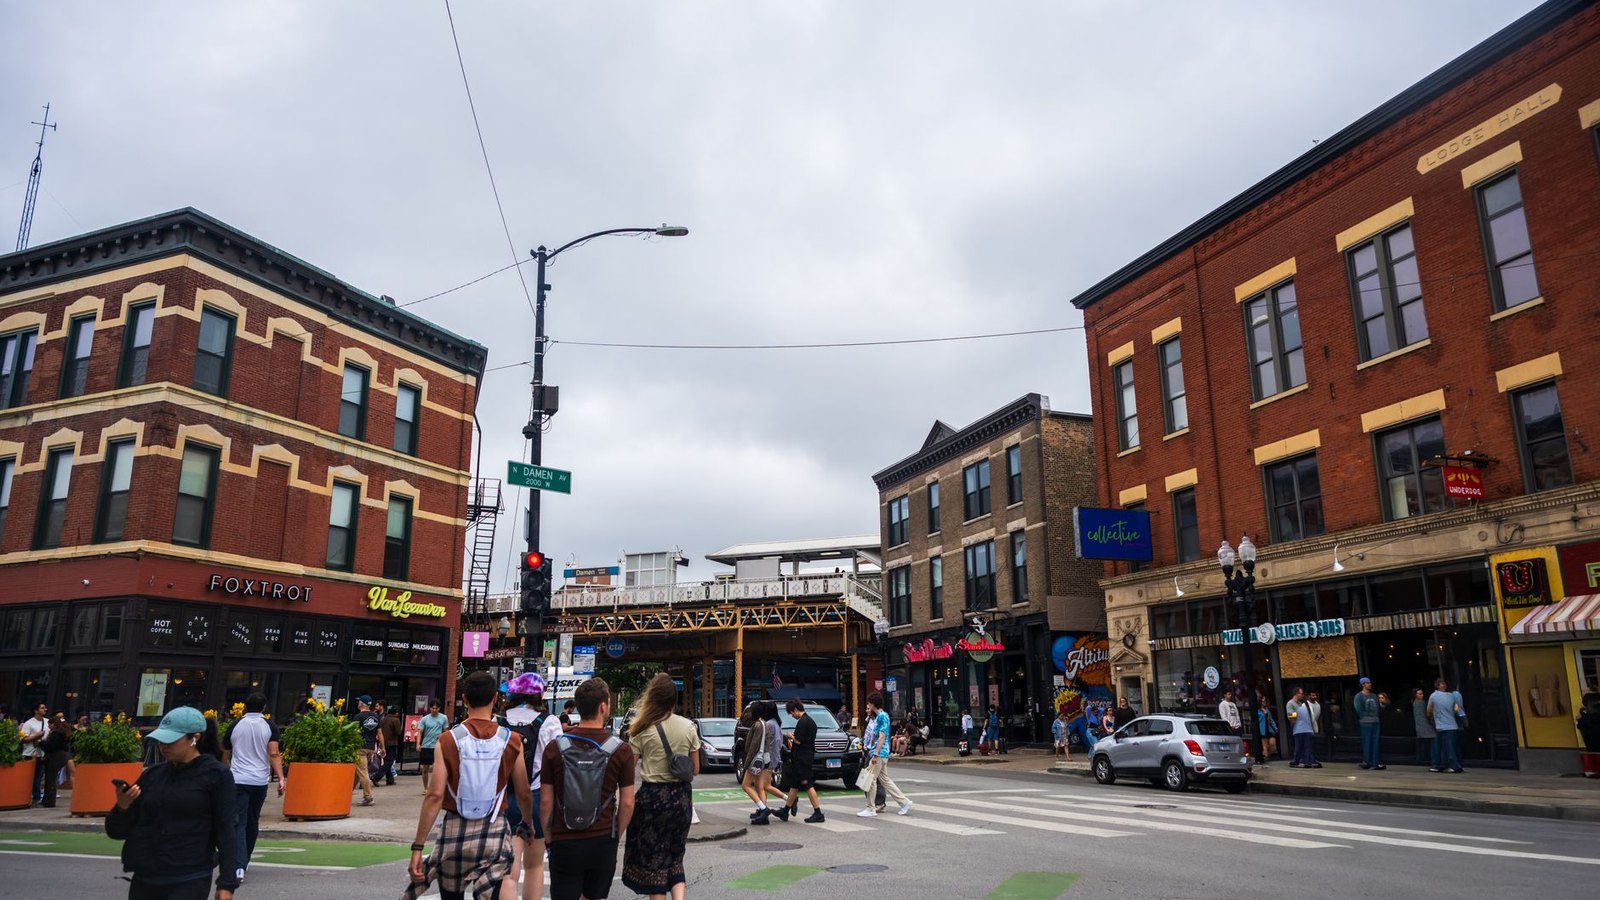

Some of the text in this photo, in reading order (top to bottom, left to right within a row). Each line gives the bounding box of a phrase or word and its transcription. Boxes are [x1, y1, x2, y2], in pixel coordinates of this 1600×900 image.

[1425, 95, 1551, 167] LODGE HALL
[523, 467, 553, 480] DAMEN
[525, 478, 542, 487] 2000
[1449, 486, 1482, 496] UNDERDOG
[1087, 520, 1140, 546] collective
[210, 575, 312, 602] FOXTROT
[368, 586, 447, 618] Van Leeuwen
[154, 619, 171, 628] HOT
[236, 622, 250, 634] ICED
[321, 631, 338, 639] GOOD
[1221, 629, 1259, 643] PIZZEIA
[1275, 621, 1307, 640] SLICES
[1316, 618, 1343, 636] SUDS
[231, 629, 251, 645] COFFEE
[388, 641, 410, 649] SUNDAES
[412, 643, 440, 652] MILKSHAKES
